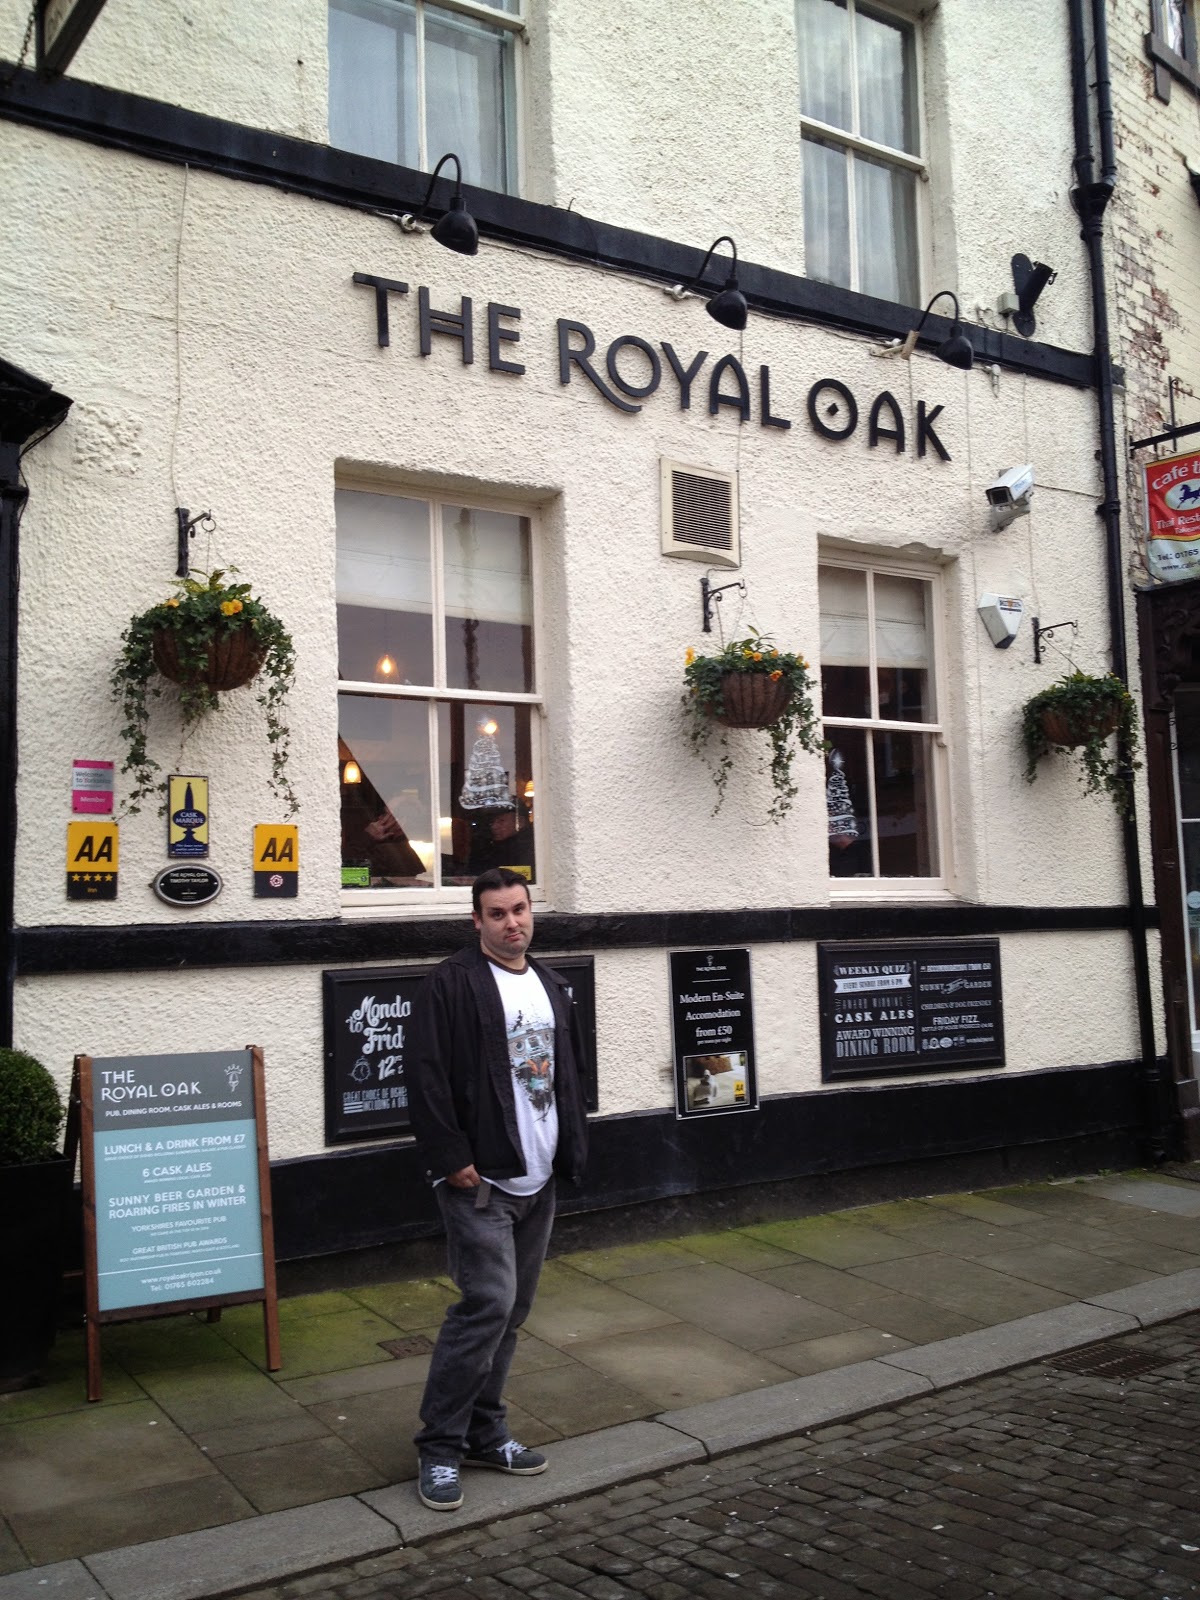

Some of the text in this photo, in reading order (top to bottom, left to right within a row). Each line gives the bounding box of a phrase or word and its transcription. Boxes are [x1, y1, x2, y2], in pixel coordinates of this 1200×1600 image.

[353, 271, 952, 462] THE ROYAL OAK
[1152, 463, 1189, 490] café
[175, 817, 204, 825] MARQUE
[74, 835, 112, 862] AA
[260, 837, 293, 862] AA
[839, 964, 906, 975] WEEKLY QUIZ
[920, 983, 944, 992] SUNNY
[964, 980, 992, 989] GARDEN
[680, 991, 745, 1004] Modern En-Suite
[352, 994, 411, 1027] Monda
[835, 1009, 914, 1023] CASK ALES
[345, 1016, 363, 1033] to
[933, 1014, 980, 1025] FRIDAY FIZZ
[362, 1022, 405, 1055] Frid
[696, 1025, 733, 1038] from £50
[836, 1025, 915, 1041] AWARD WINNING
[836, 1038, 878, 1058] DINING
[883, 1036, 916, 1054] ROOM
[101, 1070, 135, 1085] THE
[101, 1081, 202, 1103] ROYAL OAK
[123, 1107, 147, 1116] DINING
[193, 1103, 210, 1111] ALES
[217, 1100, 242, 1109] ROOMS
[104, 1143, 142, 1155] LUNCH
[145, 1141, 152, 1151] &
[155, 1141, 164, 1150] A
[166, 1138, 199, 1149] DRINK
[201, 1135, 231, 1147] FROM
[233, 1133, 246, 1143] £7
[142, 1162, 212, 1178] 6 CASK ALES
[109, 1184, 246, 1208] SUNNY BEER GARDEN &
[109, 1195, 246, 1219] ROARING FIRES IN WINTER
[131, 1222, 174, 1232] YORKSHIRES
[174, 1217, 212, 1228] FAVOURITE
[213, 1215, 227, 1223] PUB
[132, 1246, 154, 1255] GREAT
[156, 1243, 183, 1252] BRITISH
[198, 1237, 228, 1247] AWARDS
[164, 1281, 185, 1291] 01765
[187, 1277, 215, 1288] 602284
